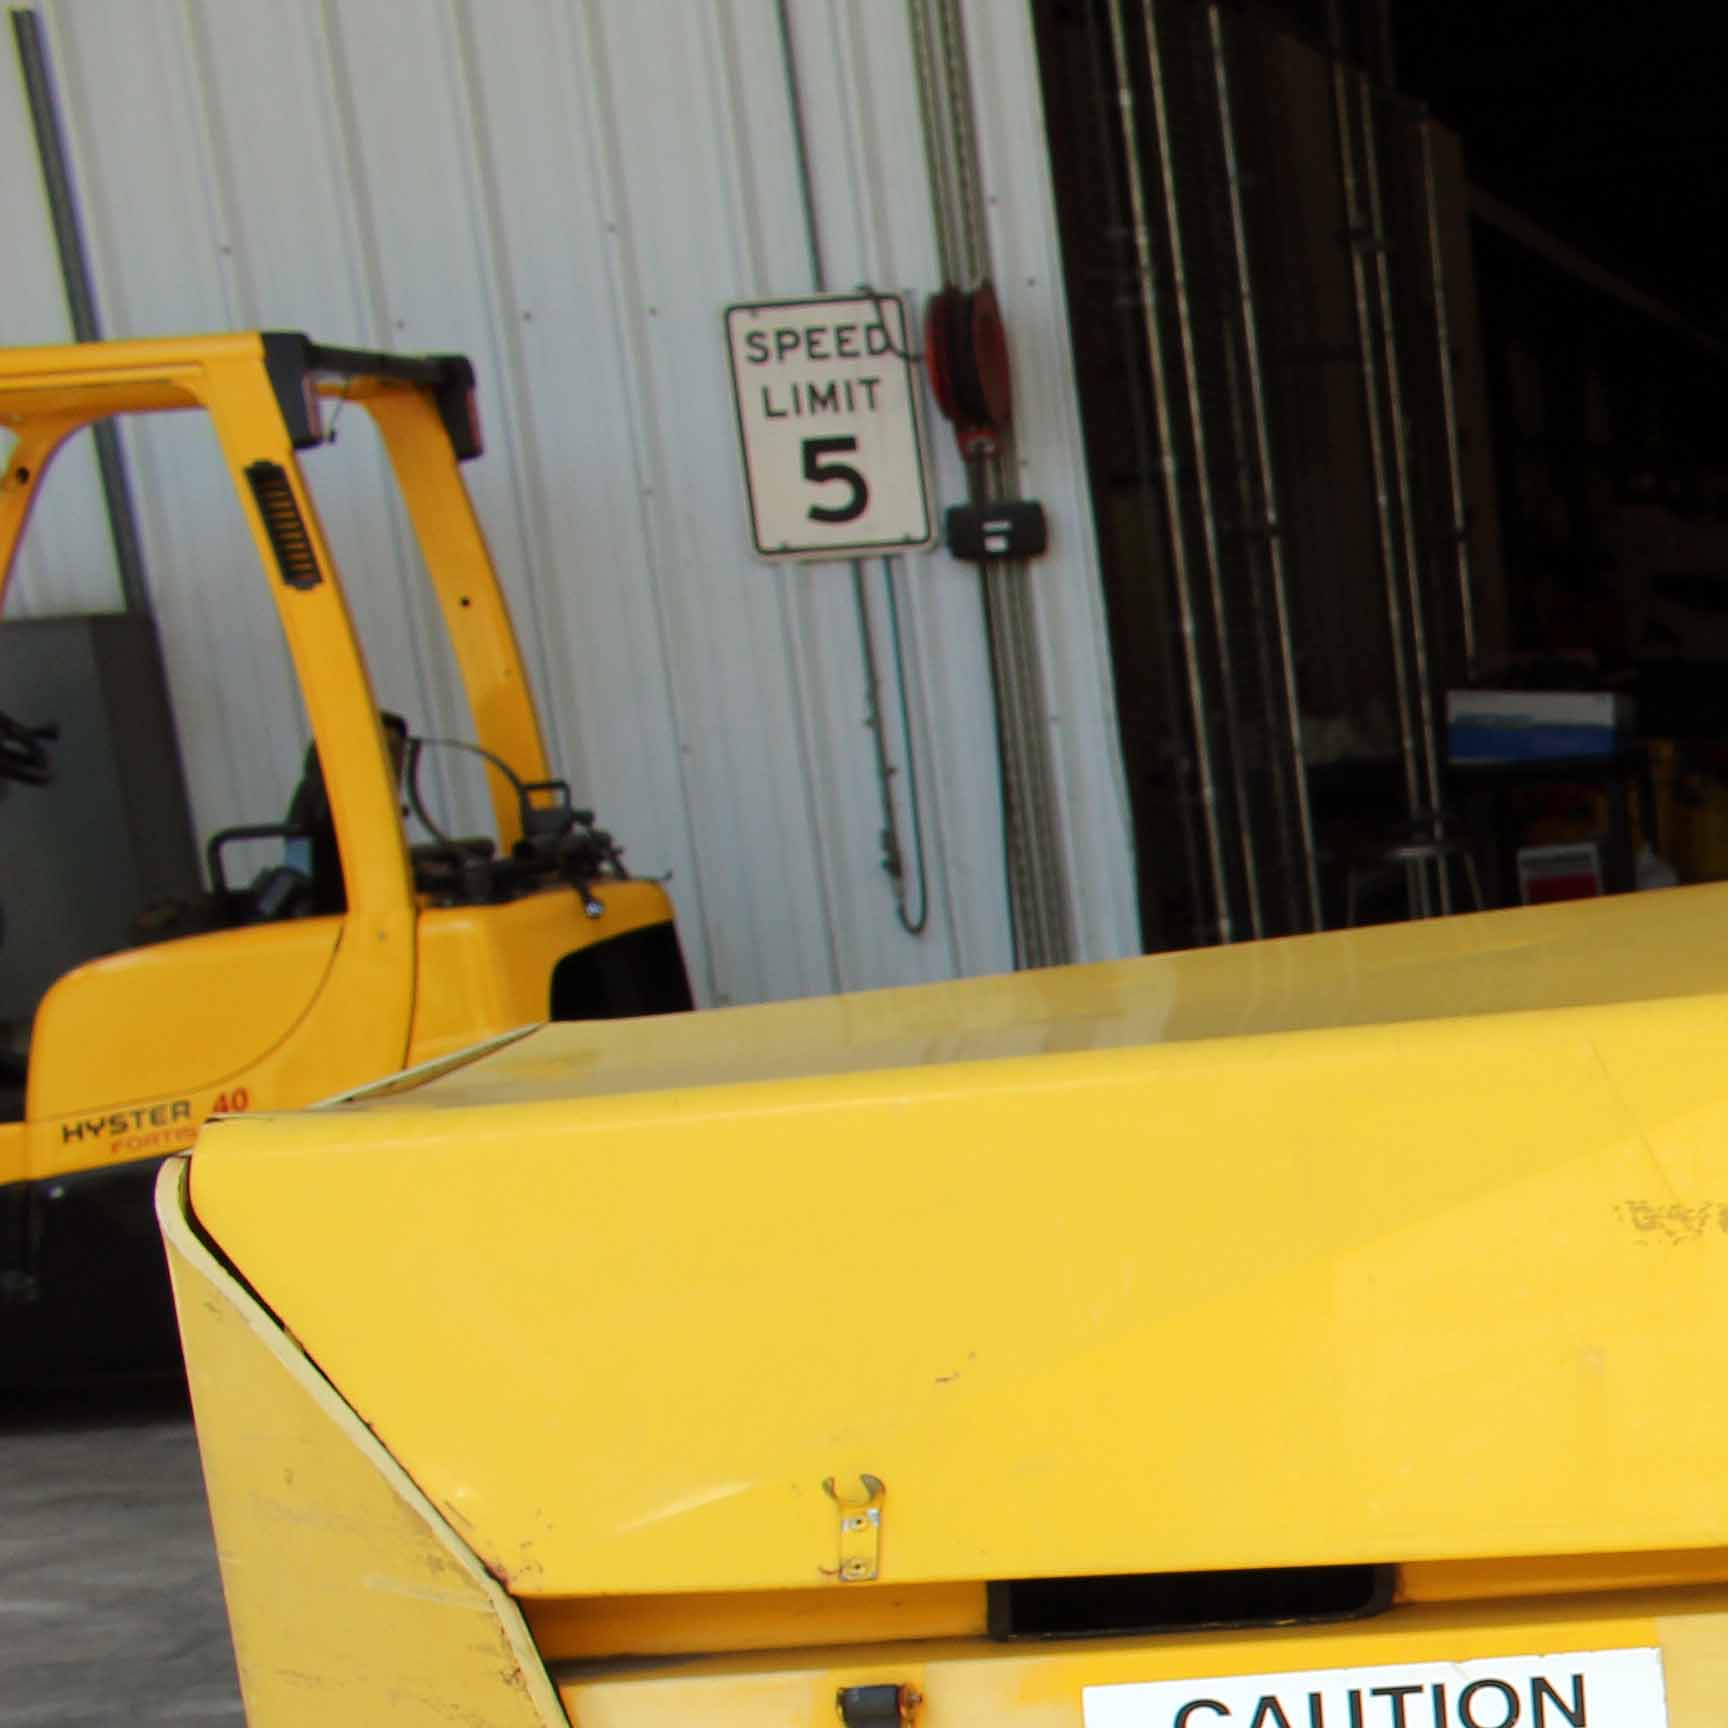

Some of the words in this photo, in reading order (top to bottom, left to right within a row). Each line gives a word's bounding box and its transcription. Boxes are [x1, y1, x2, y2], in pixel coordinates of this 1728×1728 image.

[745, 323, 891, 364] SPEED
[761, 376, 881, 419] LIMIT
[802, 436, 869, 523] 5
[62, 1100, 192, 1144] HYSTER
[213, 1087, 250, 1113] 40
